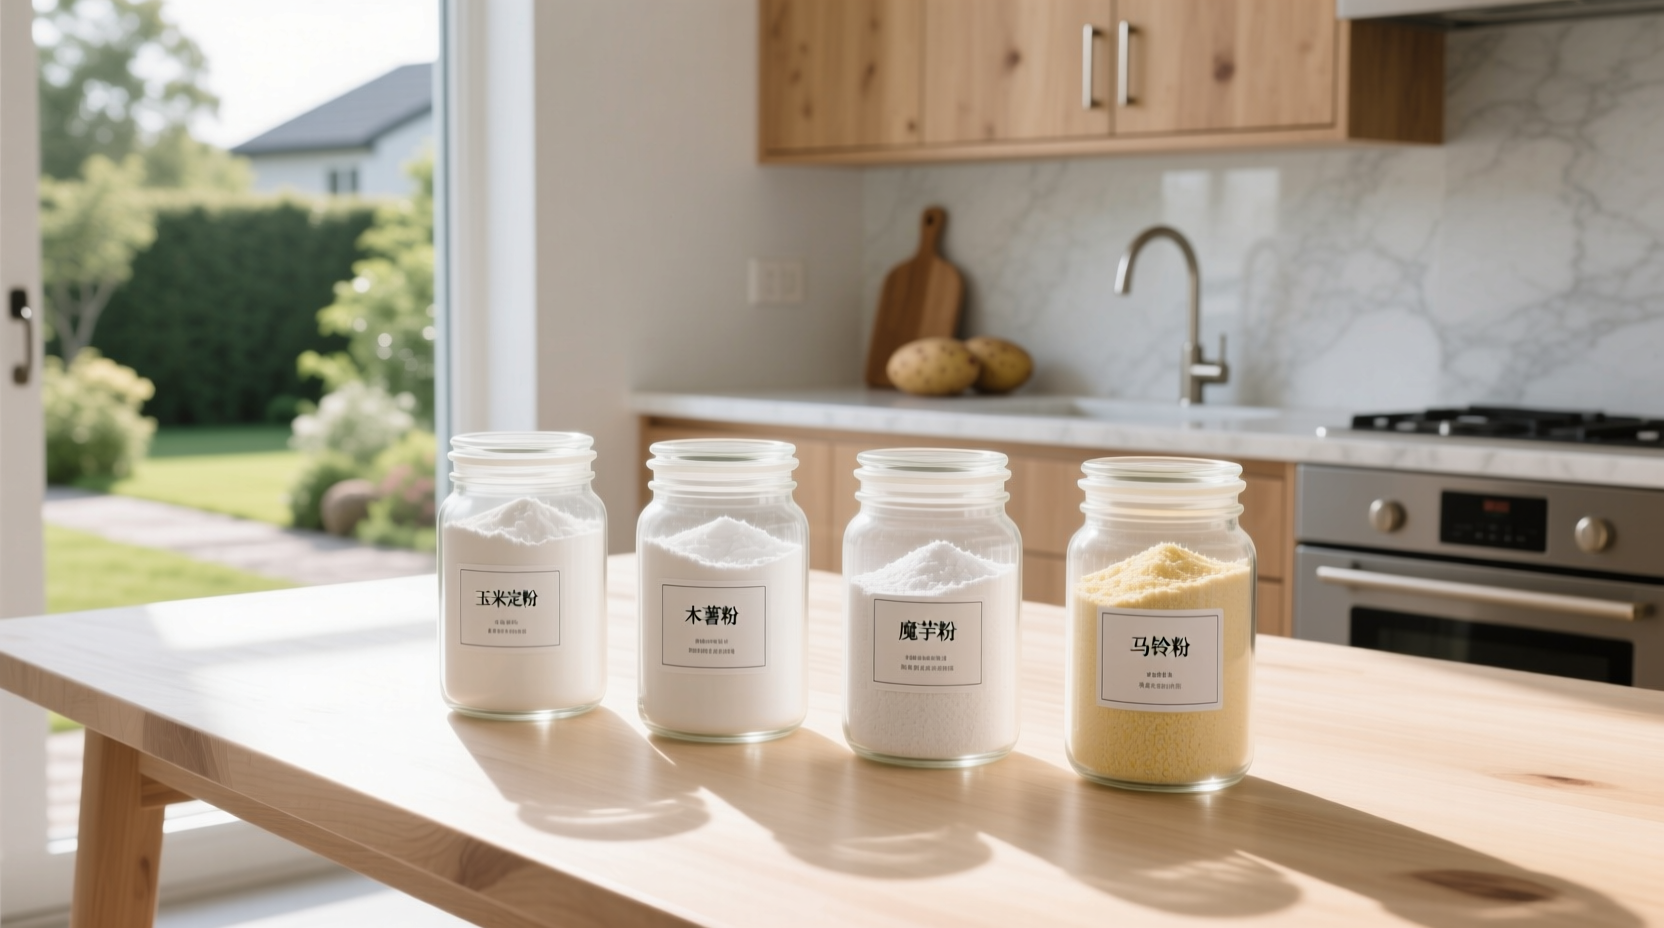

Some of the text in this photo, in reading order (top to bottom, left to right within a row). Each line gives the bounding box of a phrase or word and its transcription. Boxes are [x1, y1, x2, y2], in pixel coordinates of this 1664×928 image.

[684, 605, 739, 626] 木薯粉
[898, 620, 957, 642] 魔芋粉
[1130, 636, 1190, 658] 马铃粉
